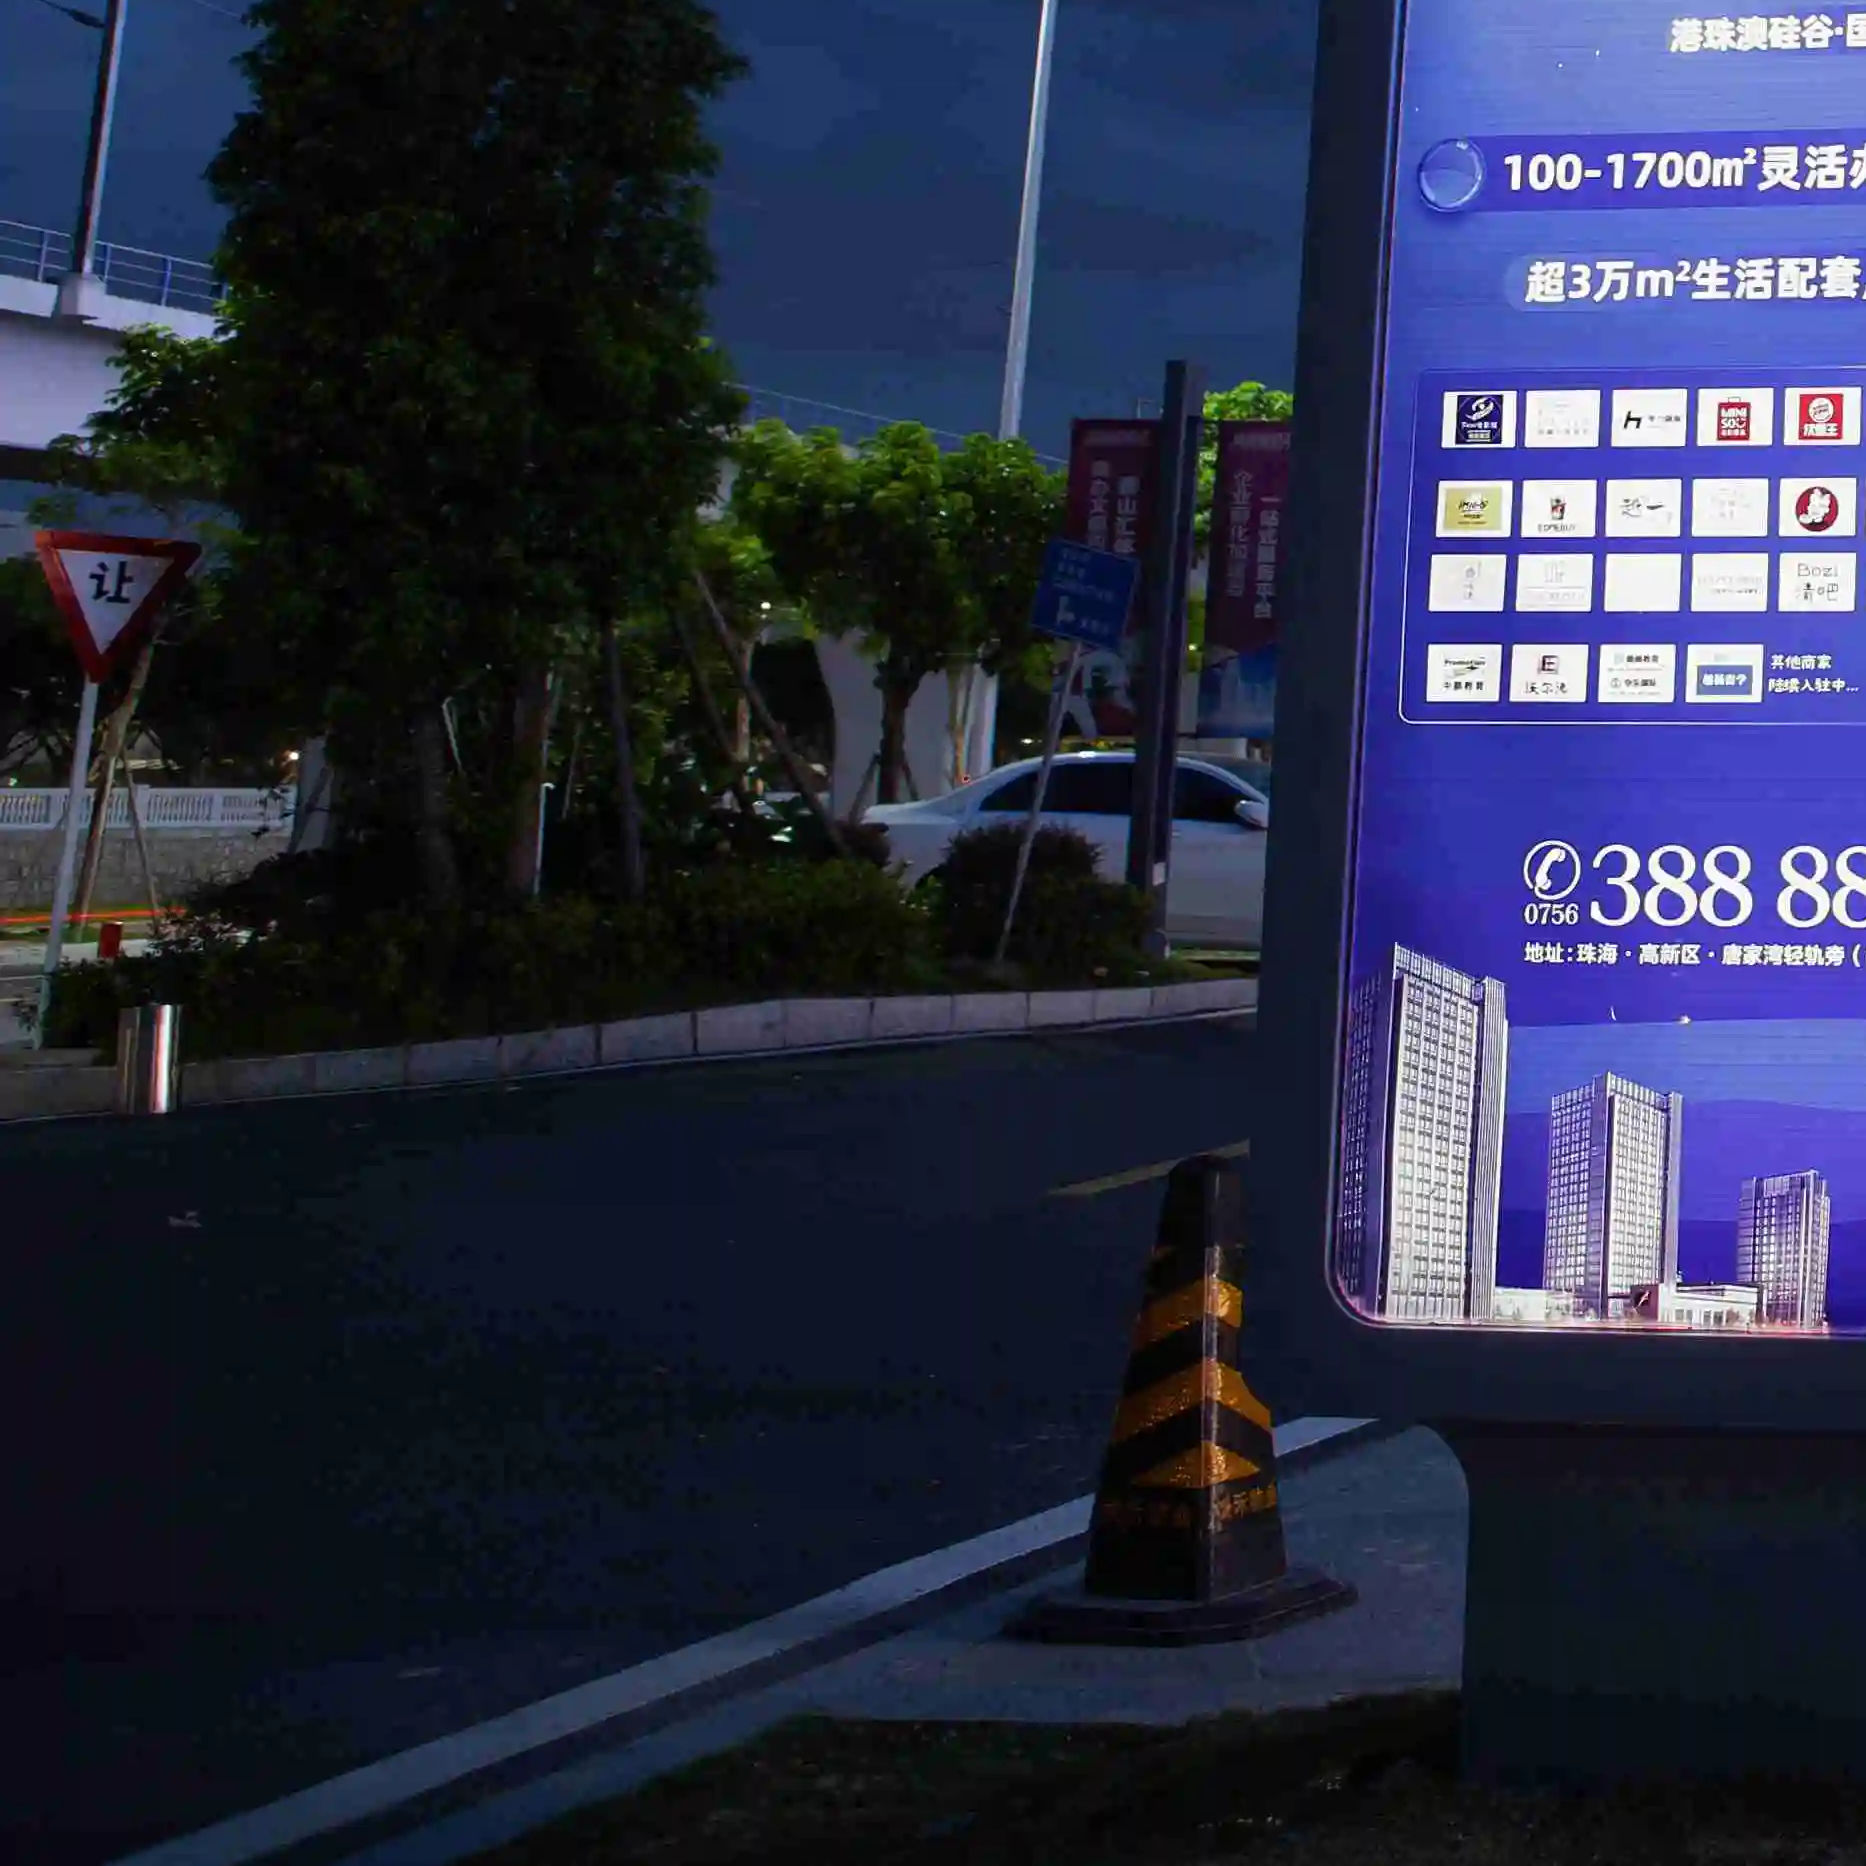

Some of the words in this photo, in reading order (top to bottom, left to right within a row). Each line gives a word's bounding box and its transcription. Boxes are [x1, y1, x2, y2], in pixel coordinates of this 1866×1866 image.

[89, 561, 134, 604] 让
[1770, 654, 1832, 670] 其他商家
[1591, 845, 1753, 927] 388
[1524, 903, 1579, 925] 0756
